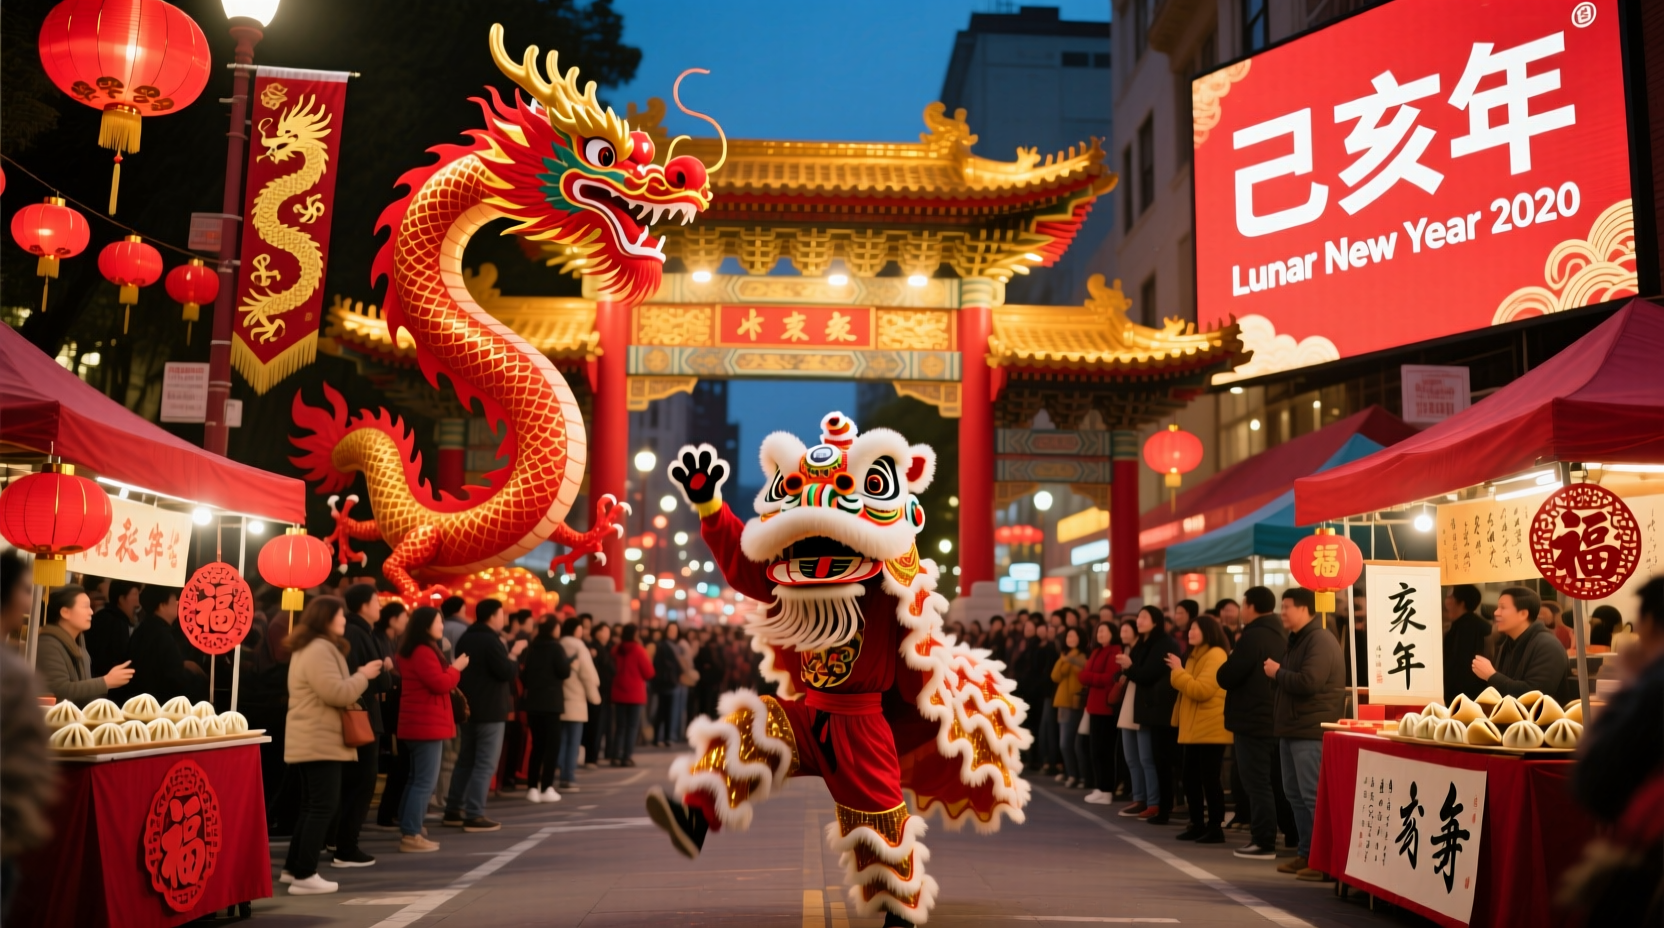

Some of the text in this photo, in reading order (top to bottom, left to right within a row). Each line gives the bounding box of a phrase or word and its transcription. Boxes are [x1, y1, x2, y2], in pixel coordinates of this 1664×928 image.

[1232, 31, 1577, 238] 己亥年
[1232, 181, 1581, 297] Lunar New Year 2020
[1311, 543, 1342, 578] 福
[1550, 510, 1620, 579] 福
[196, 583, 236, 632] 福
[1387, 581, 1427, 691] 亥年
[161, 795, 206, 888] 福
